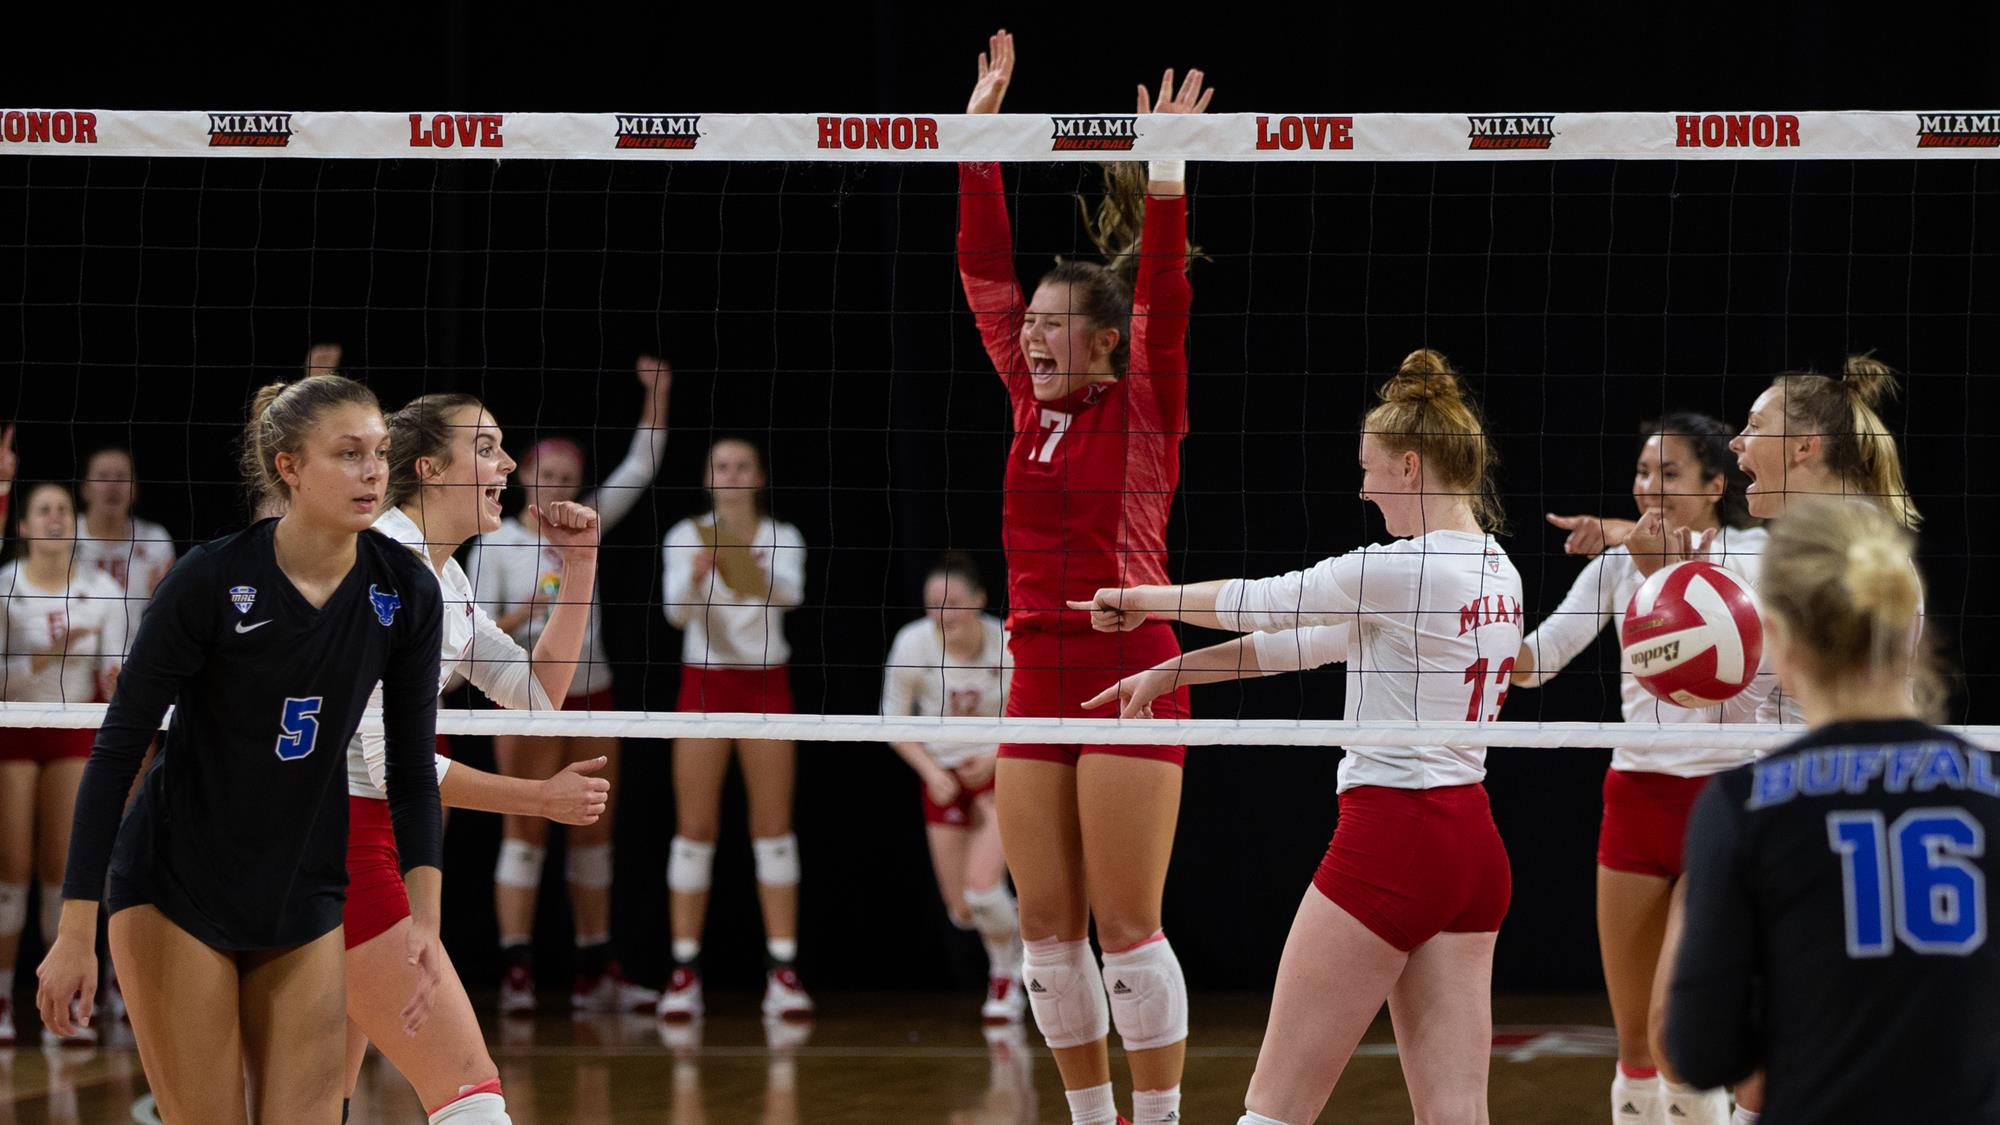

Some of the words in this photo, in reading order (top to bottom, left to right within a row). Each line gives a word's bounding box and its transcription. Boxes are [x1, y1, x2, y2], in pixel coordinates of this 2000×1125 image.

[0, 111, 97, 143] ONOR
[212, 116, 289, 133] MIAMI
[409, 114, 503, 147] LOVE
[619, 117, 697, 135] MIAMI
[817, 117, 938, 149] HONOR
[1056, 119, 1133, 136] MIAMI
[1256, 117, 1353, 149] LOVE
[1472, 118, 1549, 135] MIAMI
[1676, 115, 1800, 147] HONOR
[1922, 116, 2000, 133] MIAMI
[1631, 640, 1680, 669] Baden
[275, 696, 323, 761] 5
[1826, 807, 1988, 958] 16
